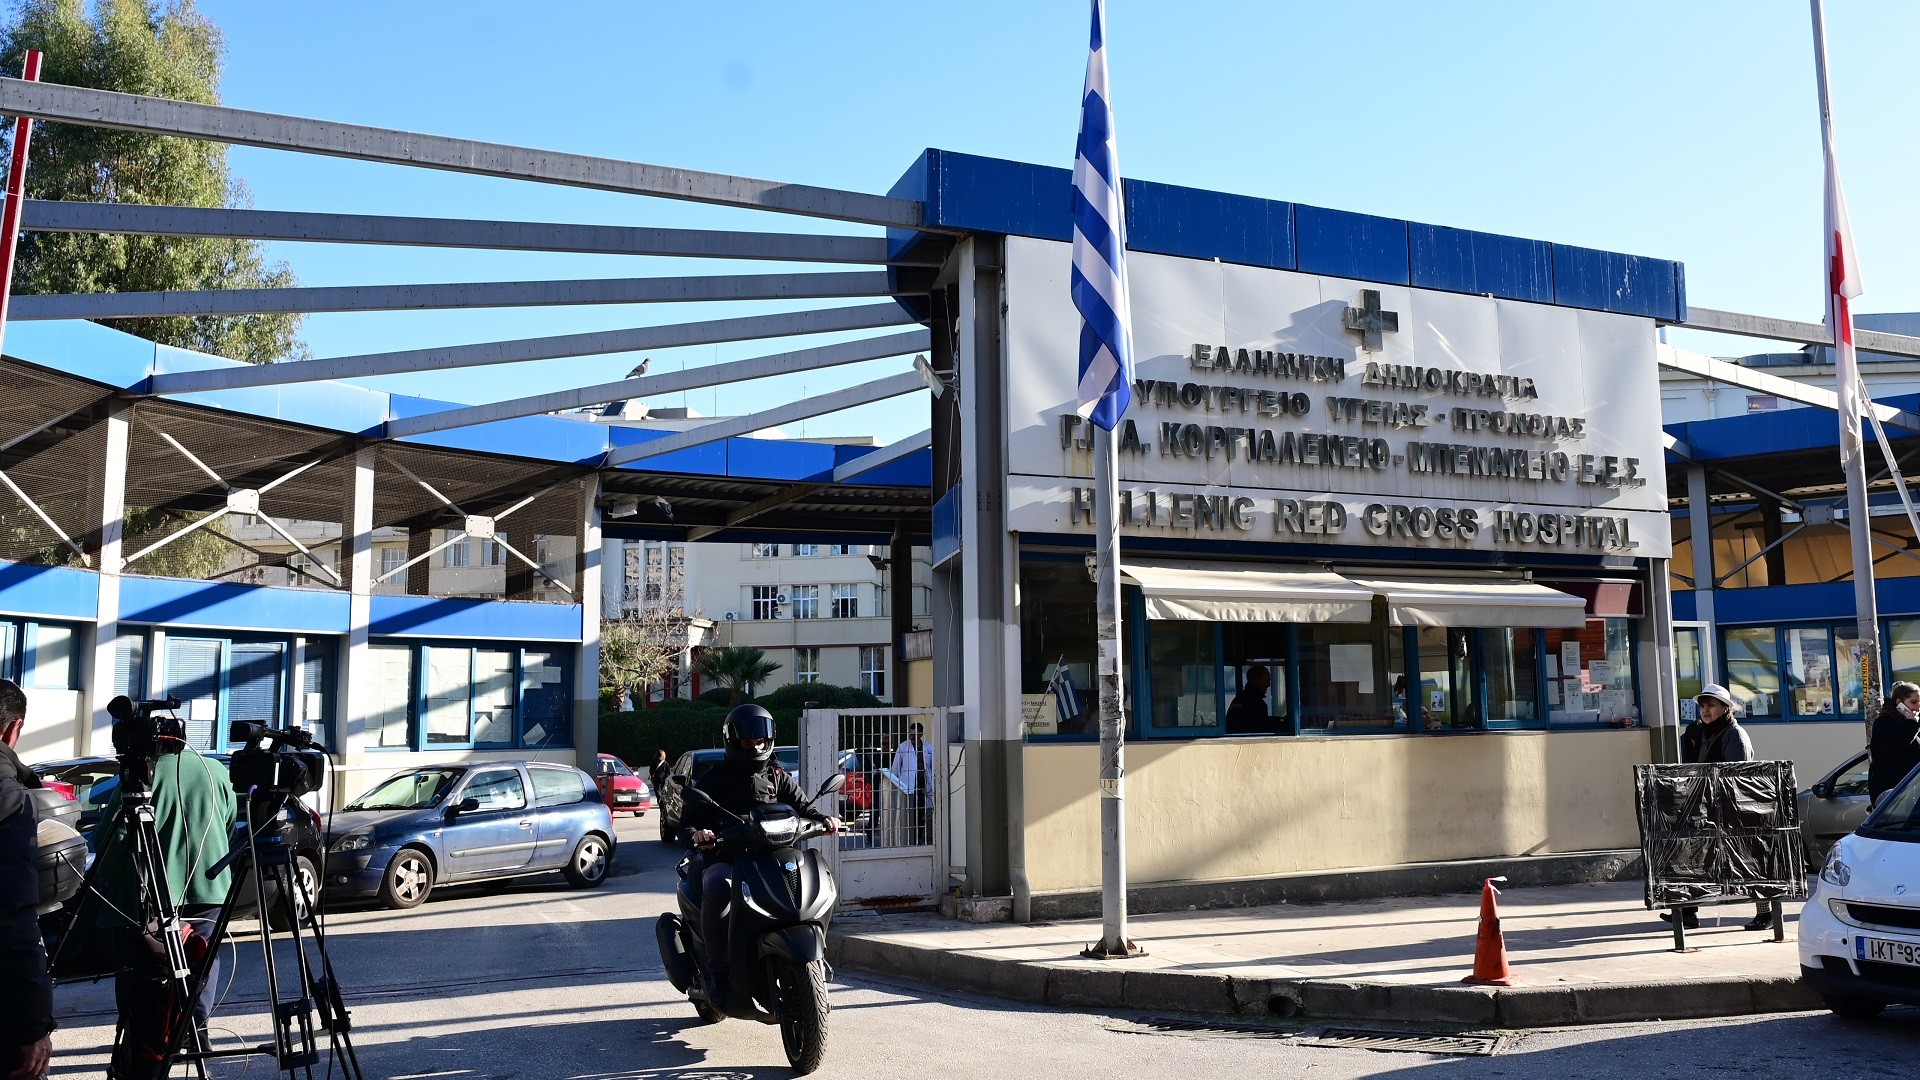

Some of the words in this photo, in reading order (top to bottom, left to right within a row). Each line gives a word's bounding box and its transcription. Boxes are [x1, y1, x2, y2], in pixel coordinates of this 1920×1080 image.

[1192, 343, 1345, 382] ΕΛΛΗΝΙΚΗ
[1362, 362, 1539, 399] ΔΗΜΟΚΡΑΤΙΑ
[1136, 378, 1311, 417] ΥΠΟΥΡΓΕΙΟ
[1326, 396, 1429, 428] ΥΓΕΙΑΣ
[1452, 407, 1586, 439] ΠΡΟΝΟΙΑΣ
[1071, 487, 1256, 531] HLLENIC
[1274, 498, 1348, 534] RED
[1361, 503, 1480, 541] CROSS
[1493, 510, 1640, 548] HOSPITAL
